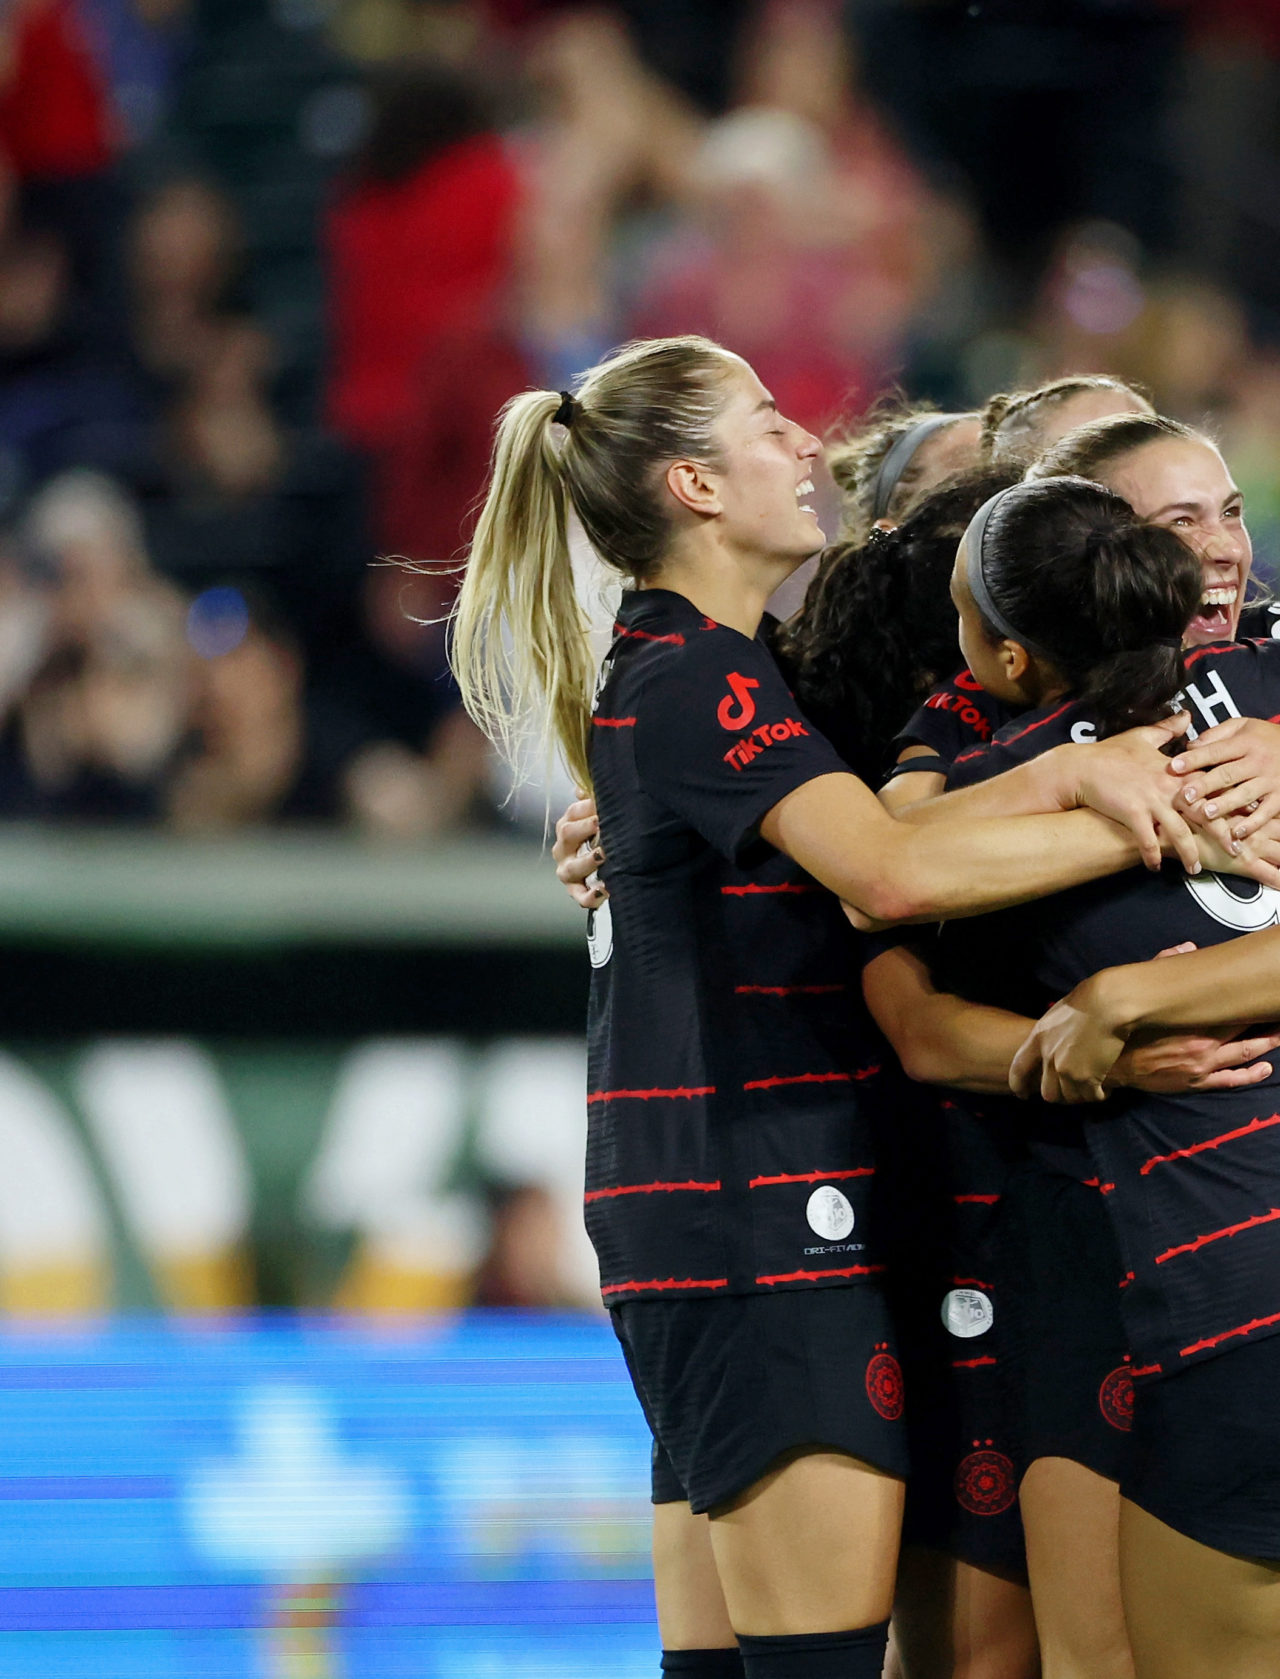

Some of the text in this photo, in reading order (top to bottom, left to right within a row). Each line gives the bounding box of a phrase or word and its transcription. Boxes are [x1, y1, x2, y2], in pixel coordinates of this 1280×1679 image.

[923, 692, 991, 740] ikTok
[1070, 669, 1243, 743] STH
[723, 718, 811, 771] TikTok
